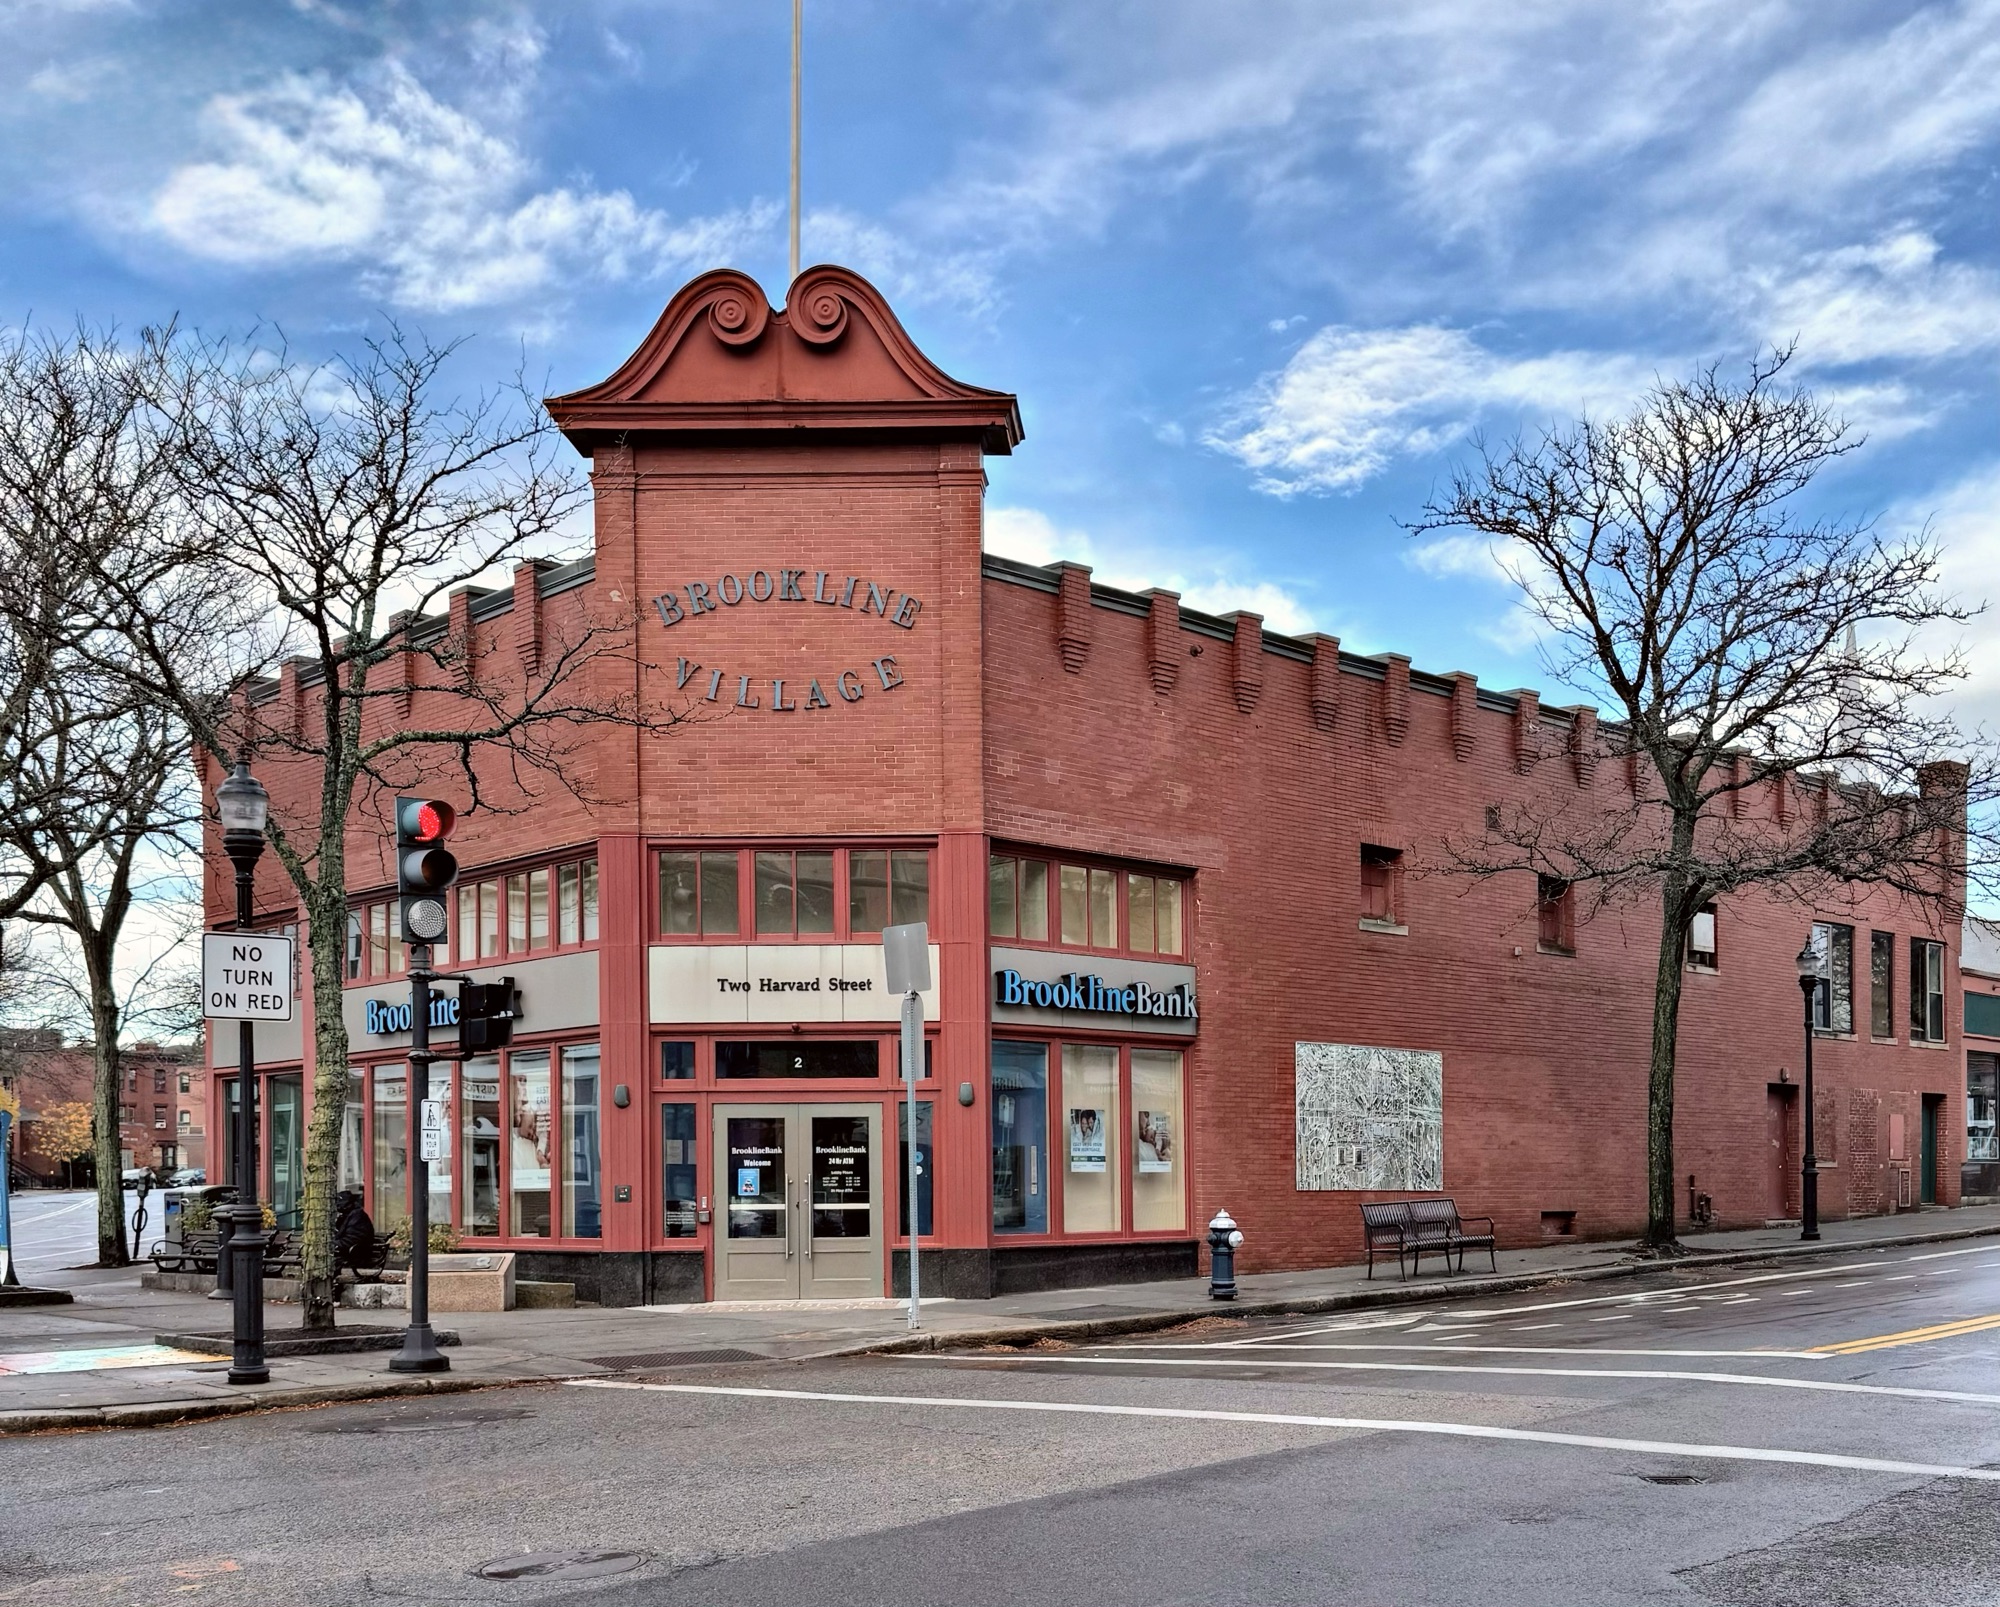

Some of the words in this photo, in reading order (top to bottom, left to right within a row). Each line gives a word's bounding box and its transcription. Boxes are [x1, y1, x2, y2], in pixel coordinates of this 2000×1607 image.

[653, 569, 922, 629] BROOKLINE
[677, 654, 904, 711] VILLAGE
[233, 946, 262, 962] NO
[223, 969, 272, 986] TURN
[717, 978, 751, 992] Two
[759, 977, 820, 992] Harvard
[828, 977, 872, 991] Street
[211, 992, 236, 1008] ON
[248, 994, 283, 1010] RED
[1001, 969, 1198, 1018] BrooklineBank
[794, 1057, 803, 1068] 2
[731, 1146, 783, 1154] BrooklineBank
[815, 1145, 867, 1154] BrooklineBank
[743, 1159, 772, 1167] Welcome
[842, 1157, 854, 1165] ATM
